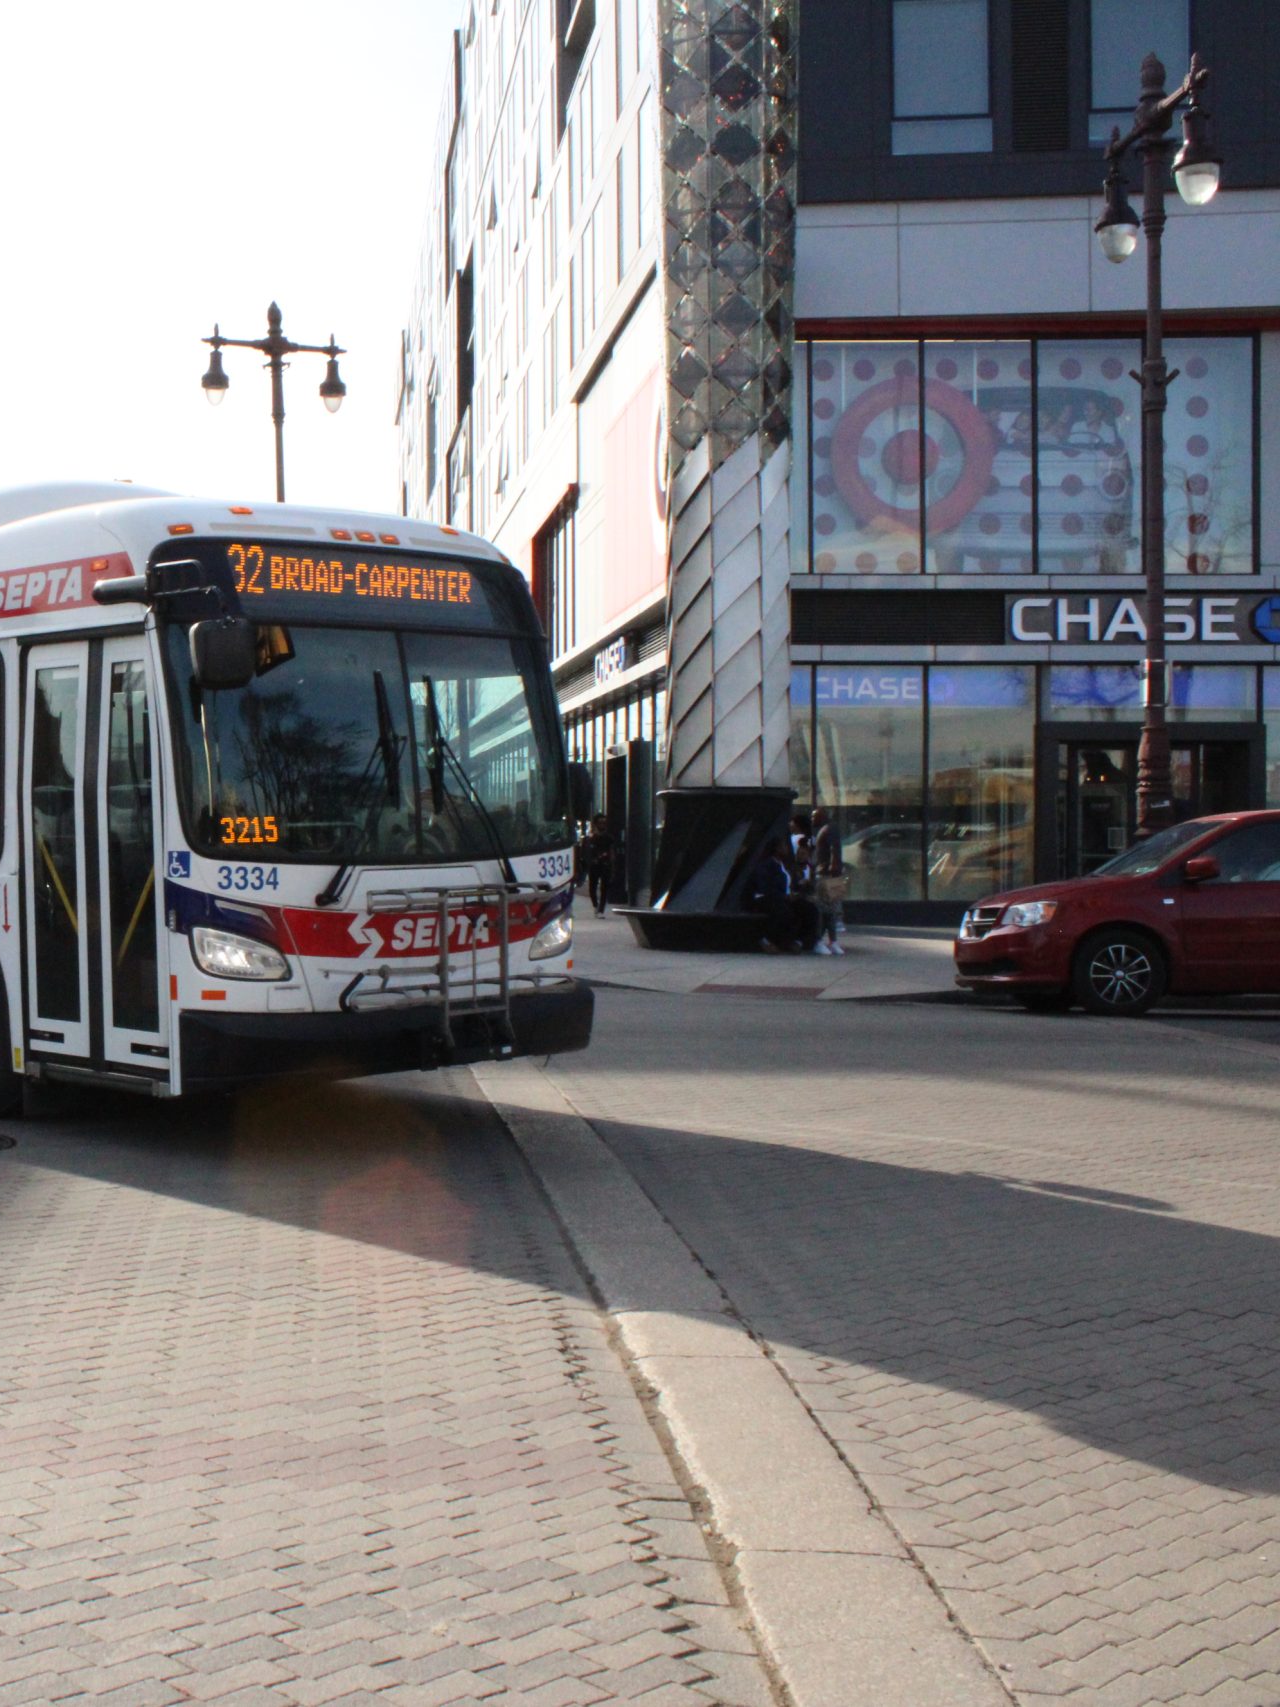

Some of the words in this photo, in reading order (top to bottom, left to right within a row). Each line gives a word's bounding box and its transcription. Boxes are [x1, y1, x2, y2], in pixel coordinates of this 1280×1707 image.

[227, 543, 265, 594] 32
[269, 555, 471, 603] BROAD-CARPENTER
[1011, 598, 1240, 641] CHASE
[816, 677, 920, 699] CHASE
[220, 816, 279, 844] 3215
[217, 865, 279, 891] 3334
[539, 853, 570, 879] 3334
[391, 913, 489, 951] SEPTA
